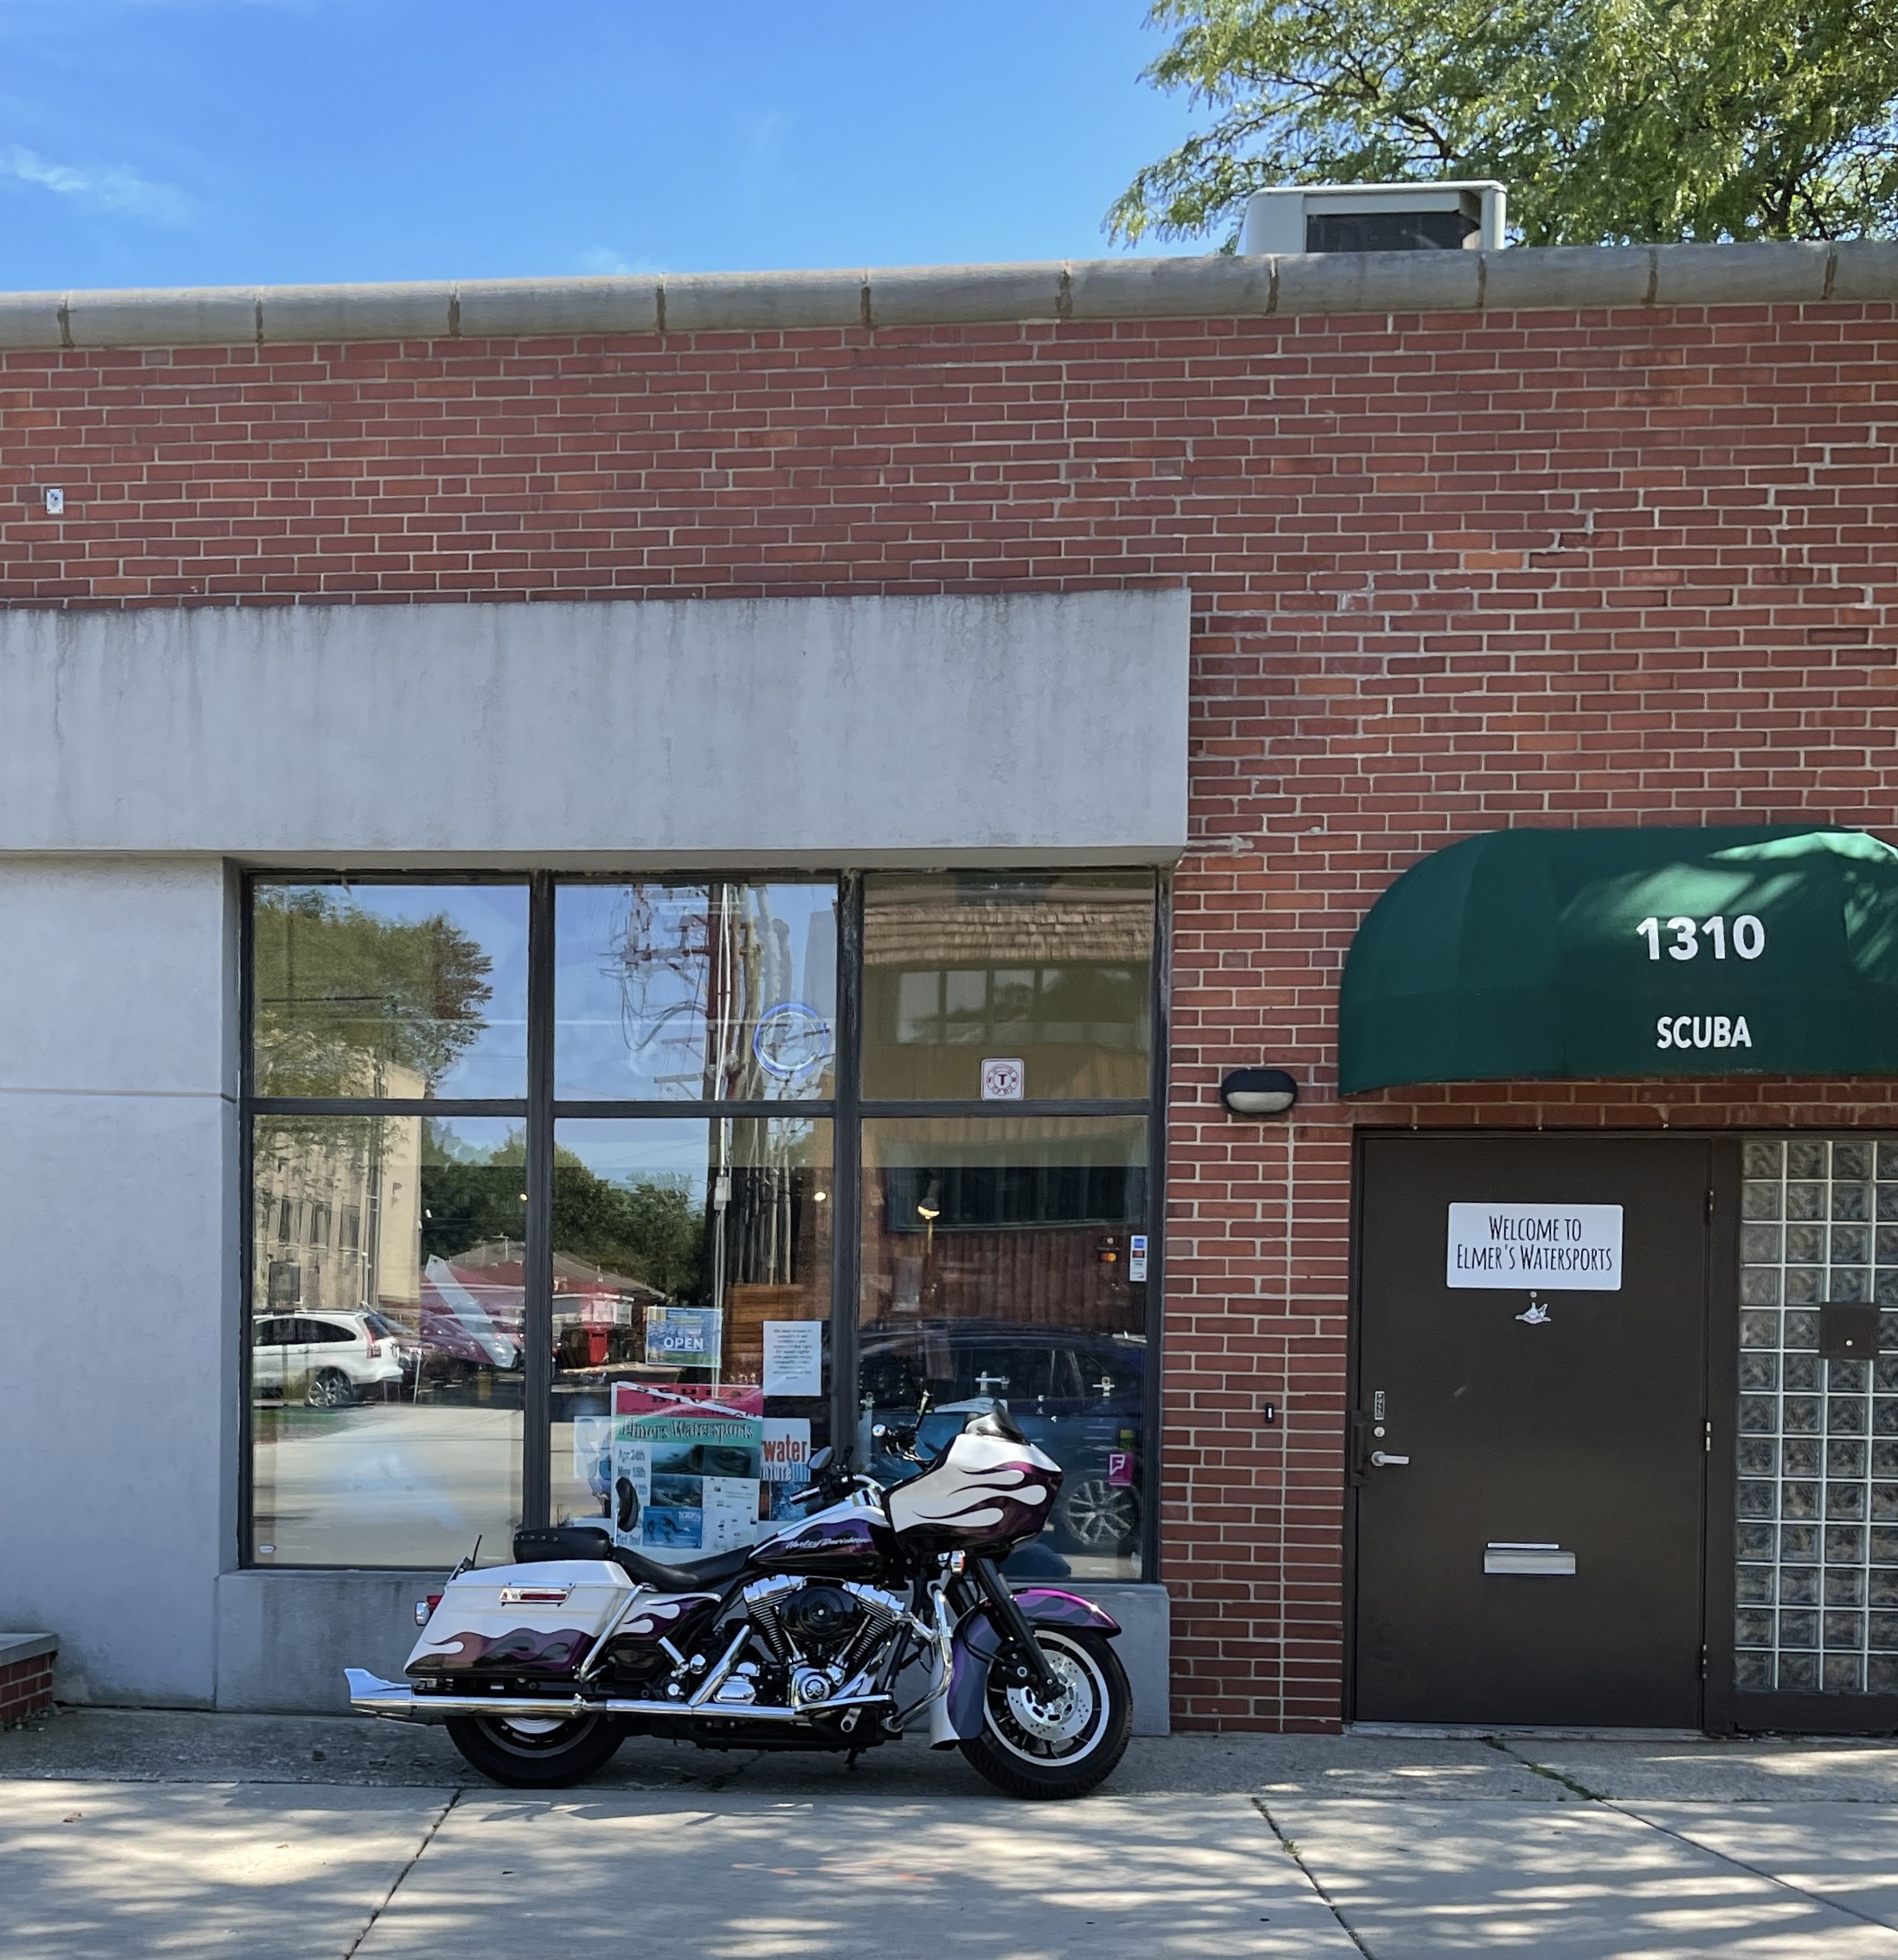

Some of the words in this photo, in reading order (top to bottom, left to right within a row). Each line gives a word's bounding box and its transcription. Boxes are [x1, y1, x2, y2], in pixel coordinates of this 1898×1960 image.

[1635, 914, 1766, 961] 1310
[1656, 1015, 1753, 1049] SCUBA
[997, 1073, 1008, 1086] T
[1489, 1214, 1560, 1242] WELCOME
[1564, 1218, 1581, 1241] TO
[1457, 1243, 1515, 1270] ELMER'S
[1520, 1243, 1613, 1271] WATERSPORTS
[663, 1336, 705, 1350] OPEN
